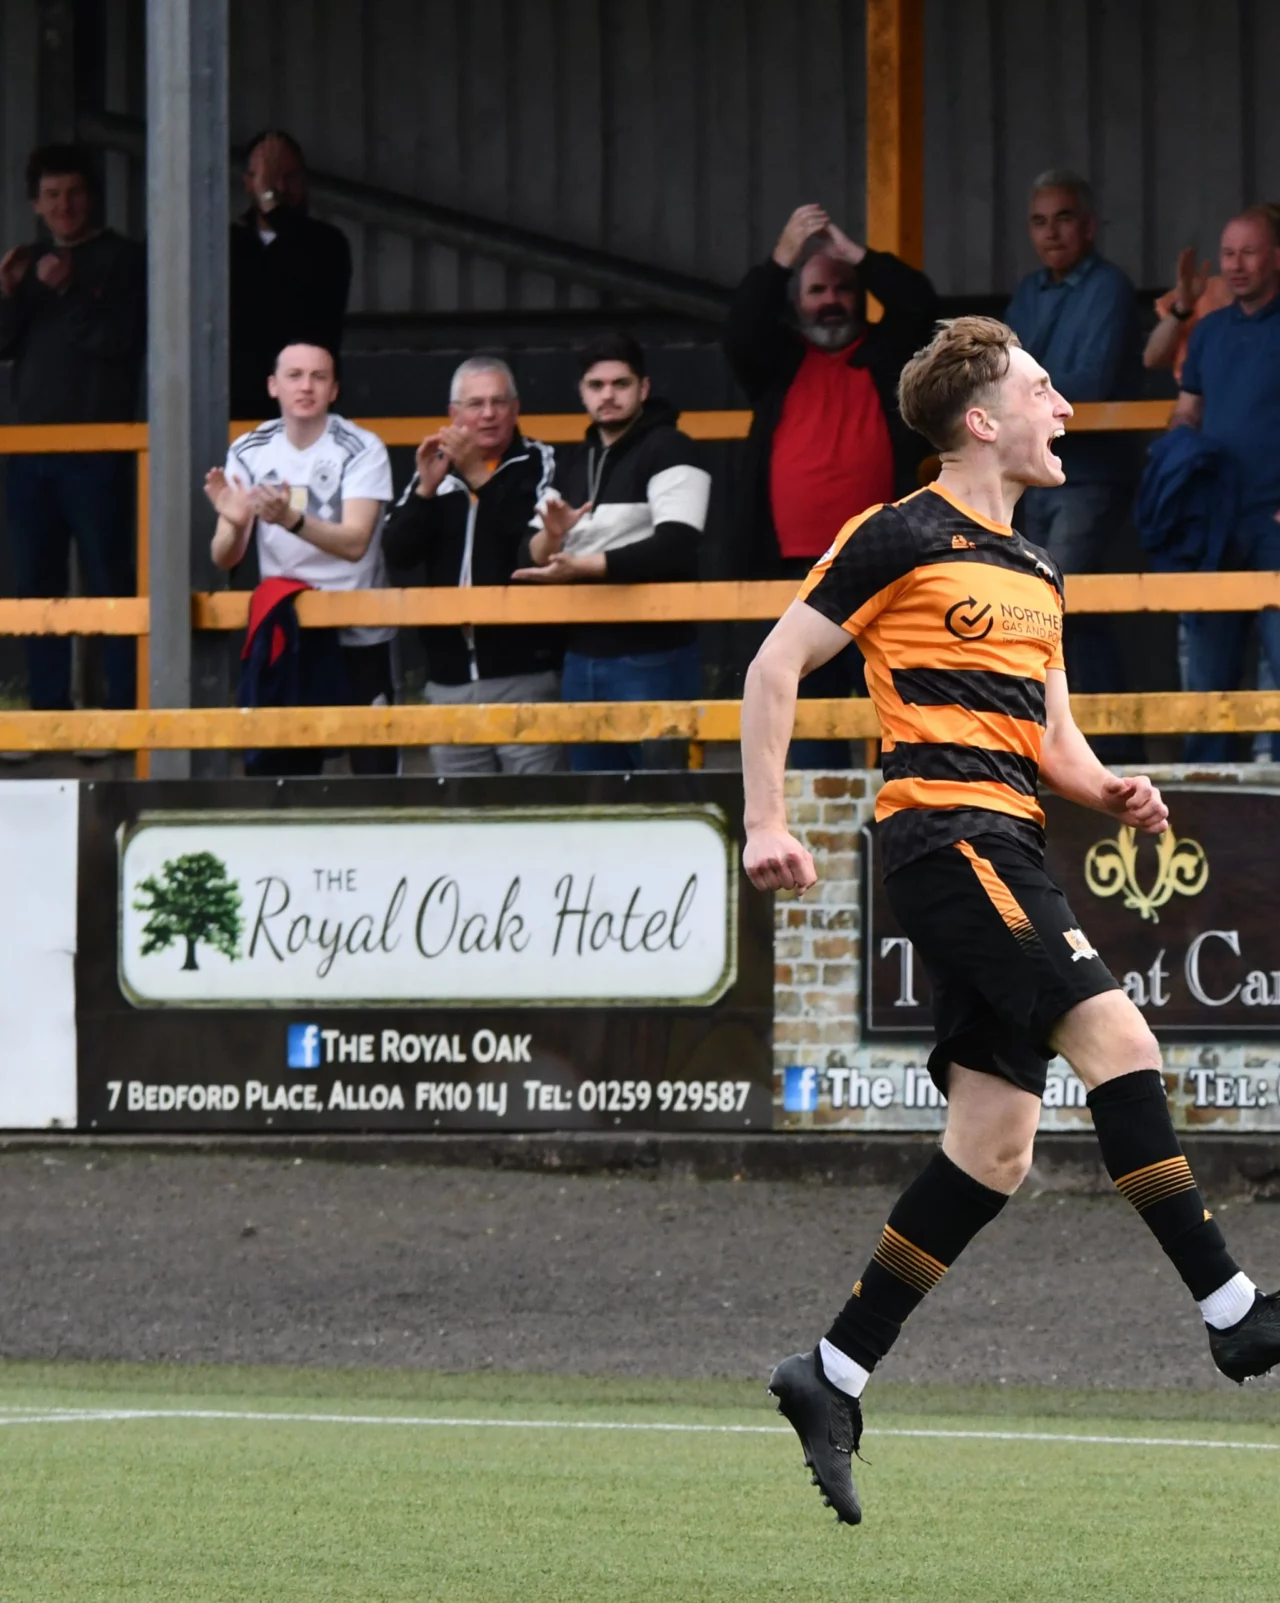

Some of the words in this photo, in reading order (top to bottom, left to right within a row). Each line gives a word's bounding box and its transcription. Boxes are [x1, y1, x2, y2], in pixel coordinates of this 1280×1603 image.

[1002, 620, 1023, 633] GAS
[1026, 625, 1046, 638] AND
[313, 868, 357, 892] THE
[248, 874, 408, 979] Royal
[415, 874, 532, 959] Oak
[552, 872, 698, 957] Hotel
[1122, 948, 1171, 1007] at
[321, 1029, 375, 1063] THE
[381, 1029, 467, 1063] ROYAL
[471, 1028, 532, 1063] OAK
[107, 1081, 122, 1111] 7
[127, 1081, 240, 1111] BEDFORD
[328, 1080, 405, 1111] ALLOA
[415, 1082, 472, 1112] FK10
[477, 1082, 508, 1117] 1LJ
[523, 1080, 573, 1112] TEL:
[577, 1080, 651, 1112] 01259
[656, 1081, 752, 1113] 929587
[827, 1066, 894, 1108] The
[904, 1066, 949, 1108] In
[1190, 1069, 1268, 1108] TEL:
